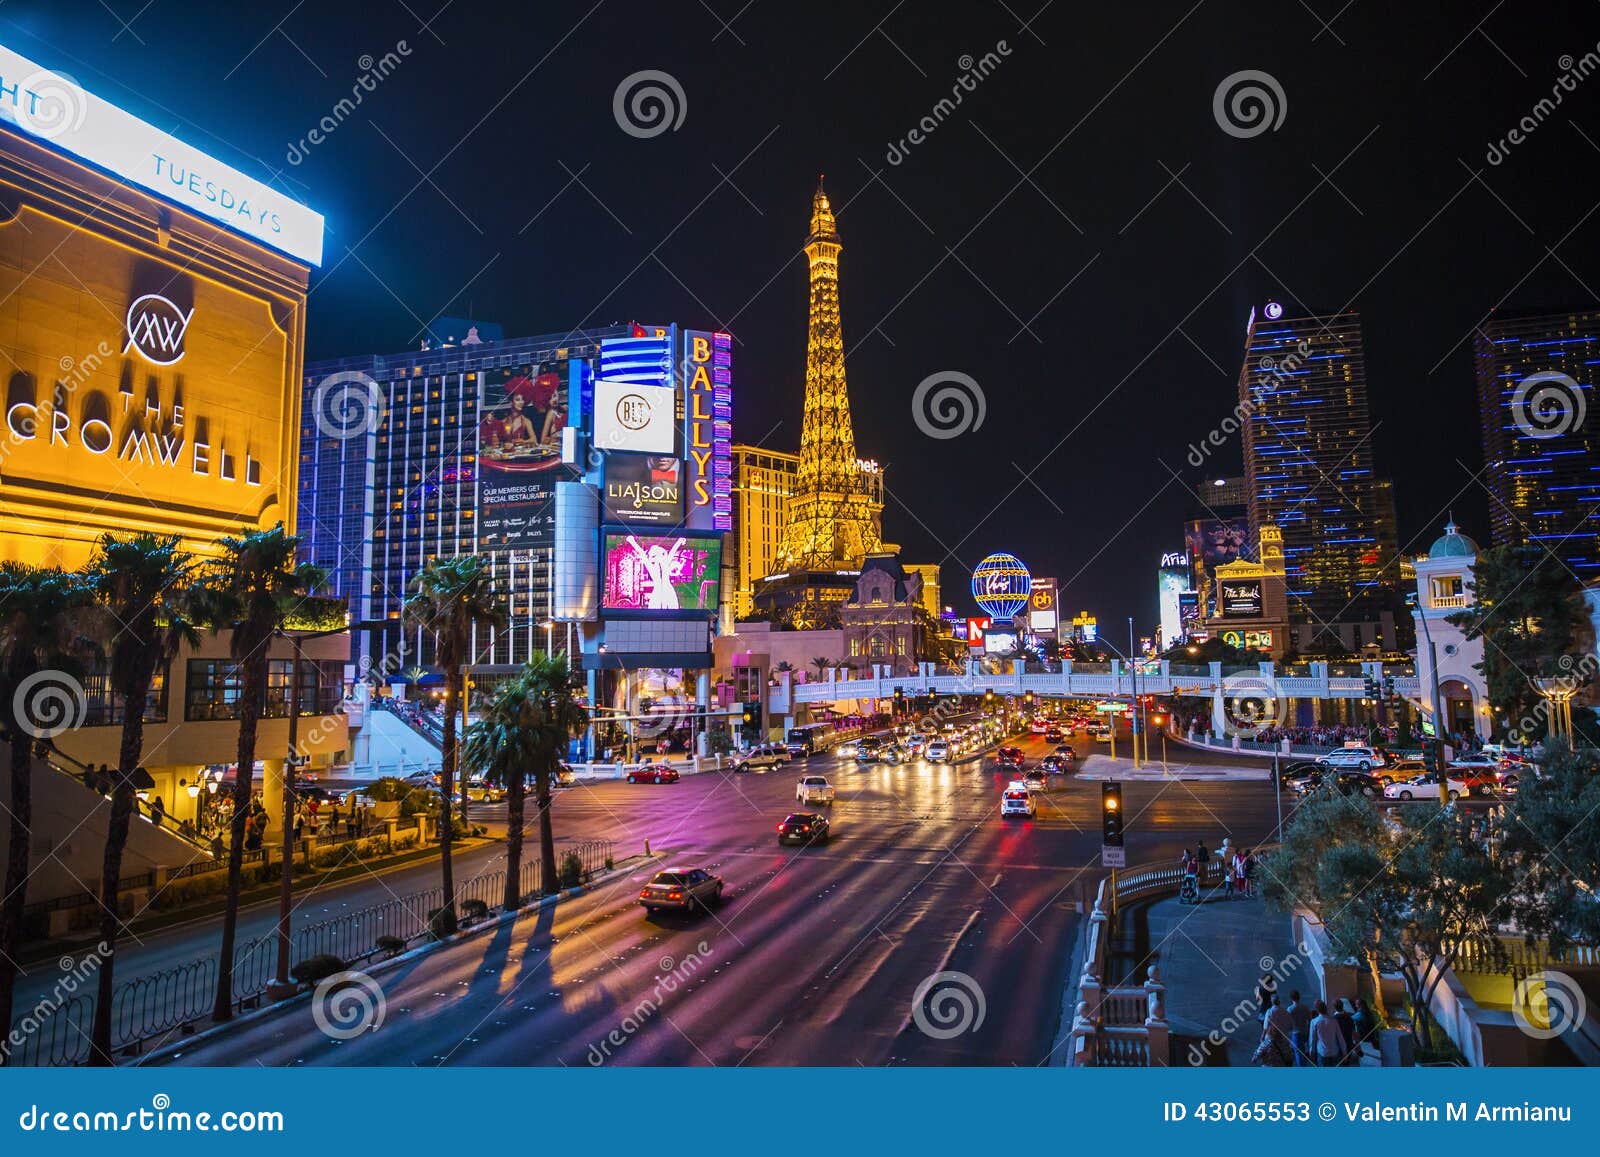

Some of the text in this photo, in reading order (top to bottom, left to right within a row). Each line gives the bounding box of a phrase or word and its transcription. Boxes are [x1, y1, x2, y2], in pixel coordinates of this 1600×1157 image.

[151, 153, 282, 234] TUESDAYS
[7, 402, 261, 487] CROMWELL
[119, 391, 184, 427] THE
